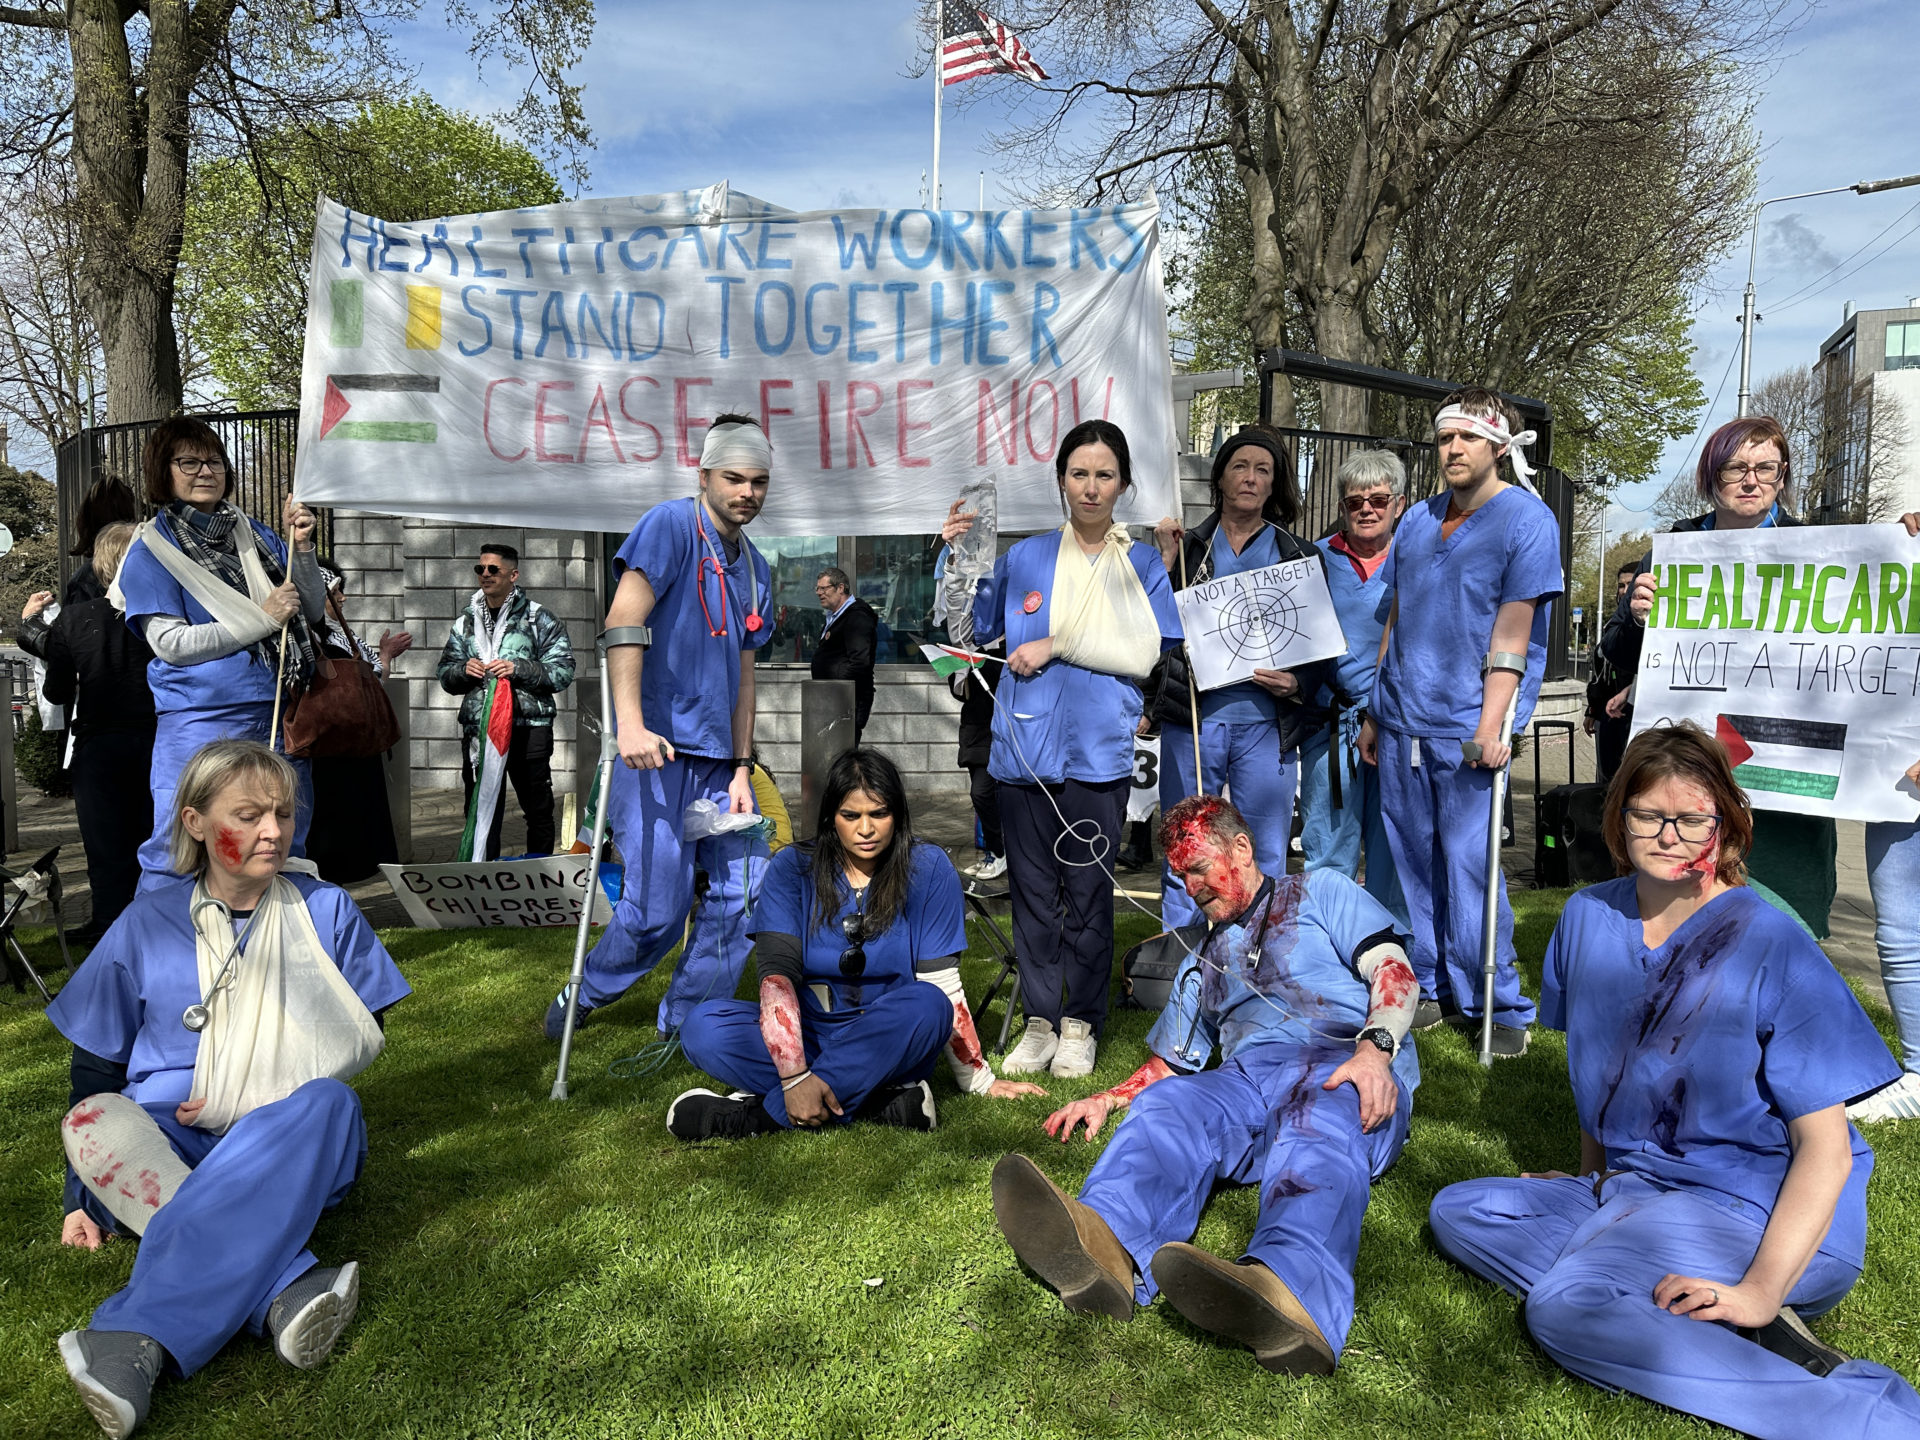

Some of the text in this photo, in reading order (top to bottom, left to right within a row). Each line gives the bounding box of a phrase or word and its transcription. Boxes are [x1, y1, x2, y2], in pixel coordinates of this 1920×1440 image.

[831, 203, 1145, 273] WORKERS
[457, 276, 1063, 369] STAND TOGETHER
[484, 376, 713, 467] CEASE
[759, 378, 934, 470] FIRE
[1194, 560, 1311, 604] NOT A TARGET
[1672, 642, 1737, 686] NOT
[1745, 642, 1774, 689] A
[1789, 642, 1920, 696] TARGET
[400, 868, 586, 894] BOMBING
[476, 914, 505, 926] IS
